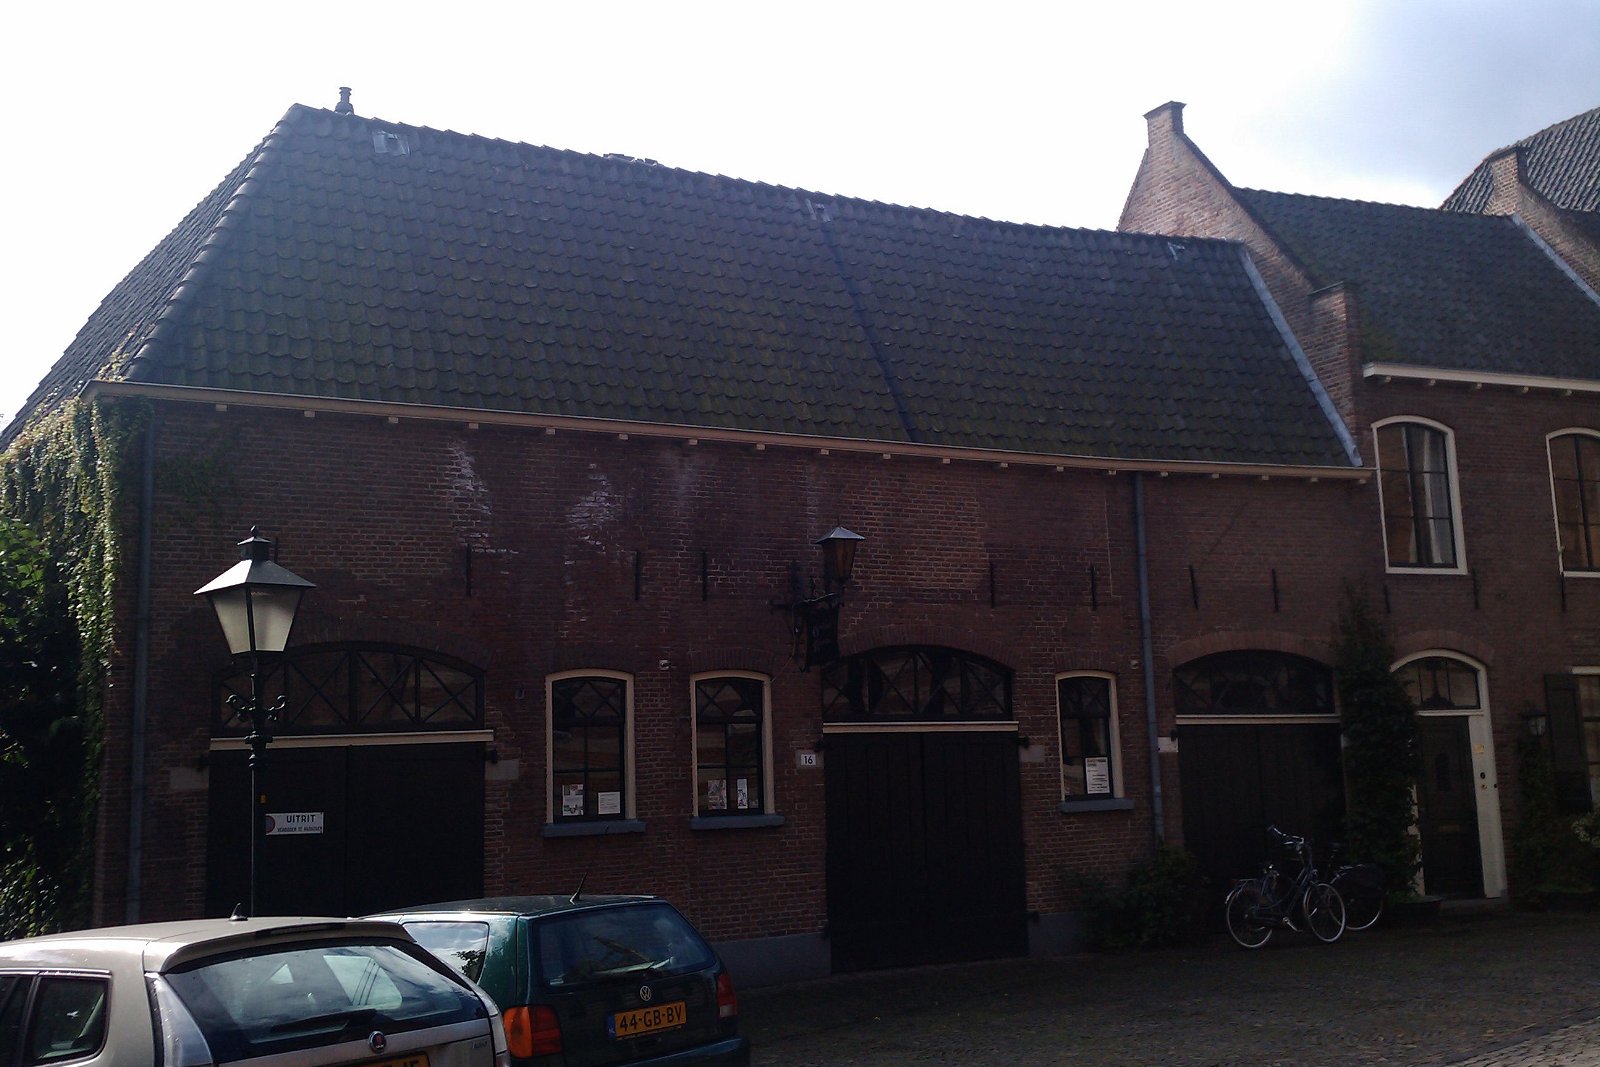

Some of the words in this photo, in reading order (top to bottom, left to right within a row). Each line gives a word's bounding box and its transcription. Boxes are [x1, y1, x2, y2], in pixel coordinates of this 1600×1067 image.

[804, 755, 813, 765] 16
[286, 814, 316, 824] UITRIT
[619, 1004, 683, 1032] 44-GB-BV
